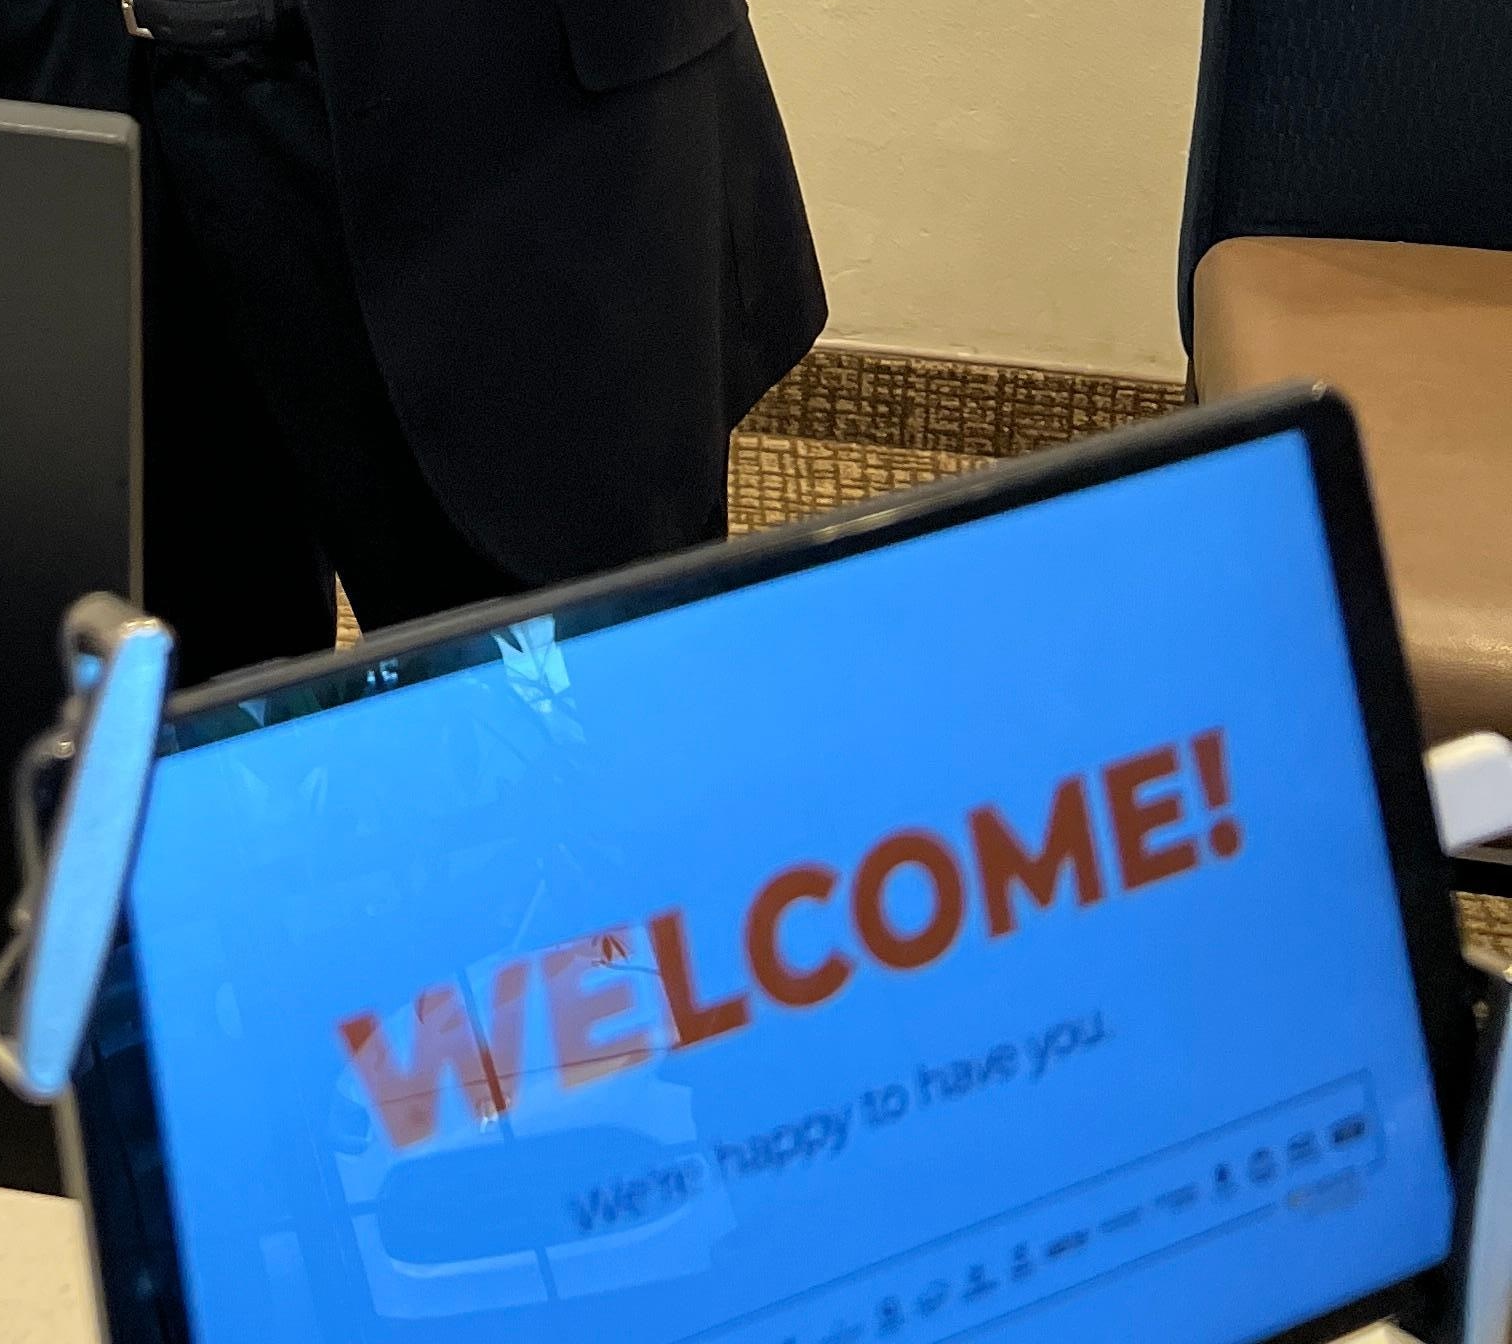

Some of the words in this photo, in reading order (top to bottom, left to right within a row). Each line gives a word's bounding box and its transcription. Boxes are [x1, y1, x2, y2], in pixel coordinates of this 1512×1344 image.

[335, 725, 1245, 1148] WELCOME!
[567, 1144, 706, 1234] We're
[713, 1090, 854, 1180] happy
[859, 1082, 913, 1132] to
[916, 1040, 1024, 1107] have
